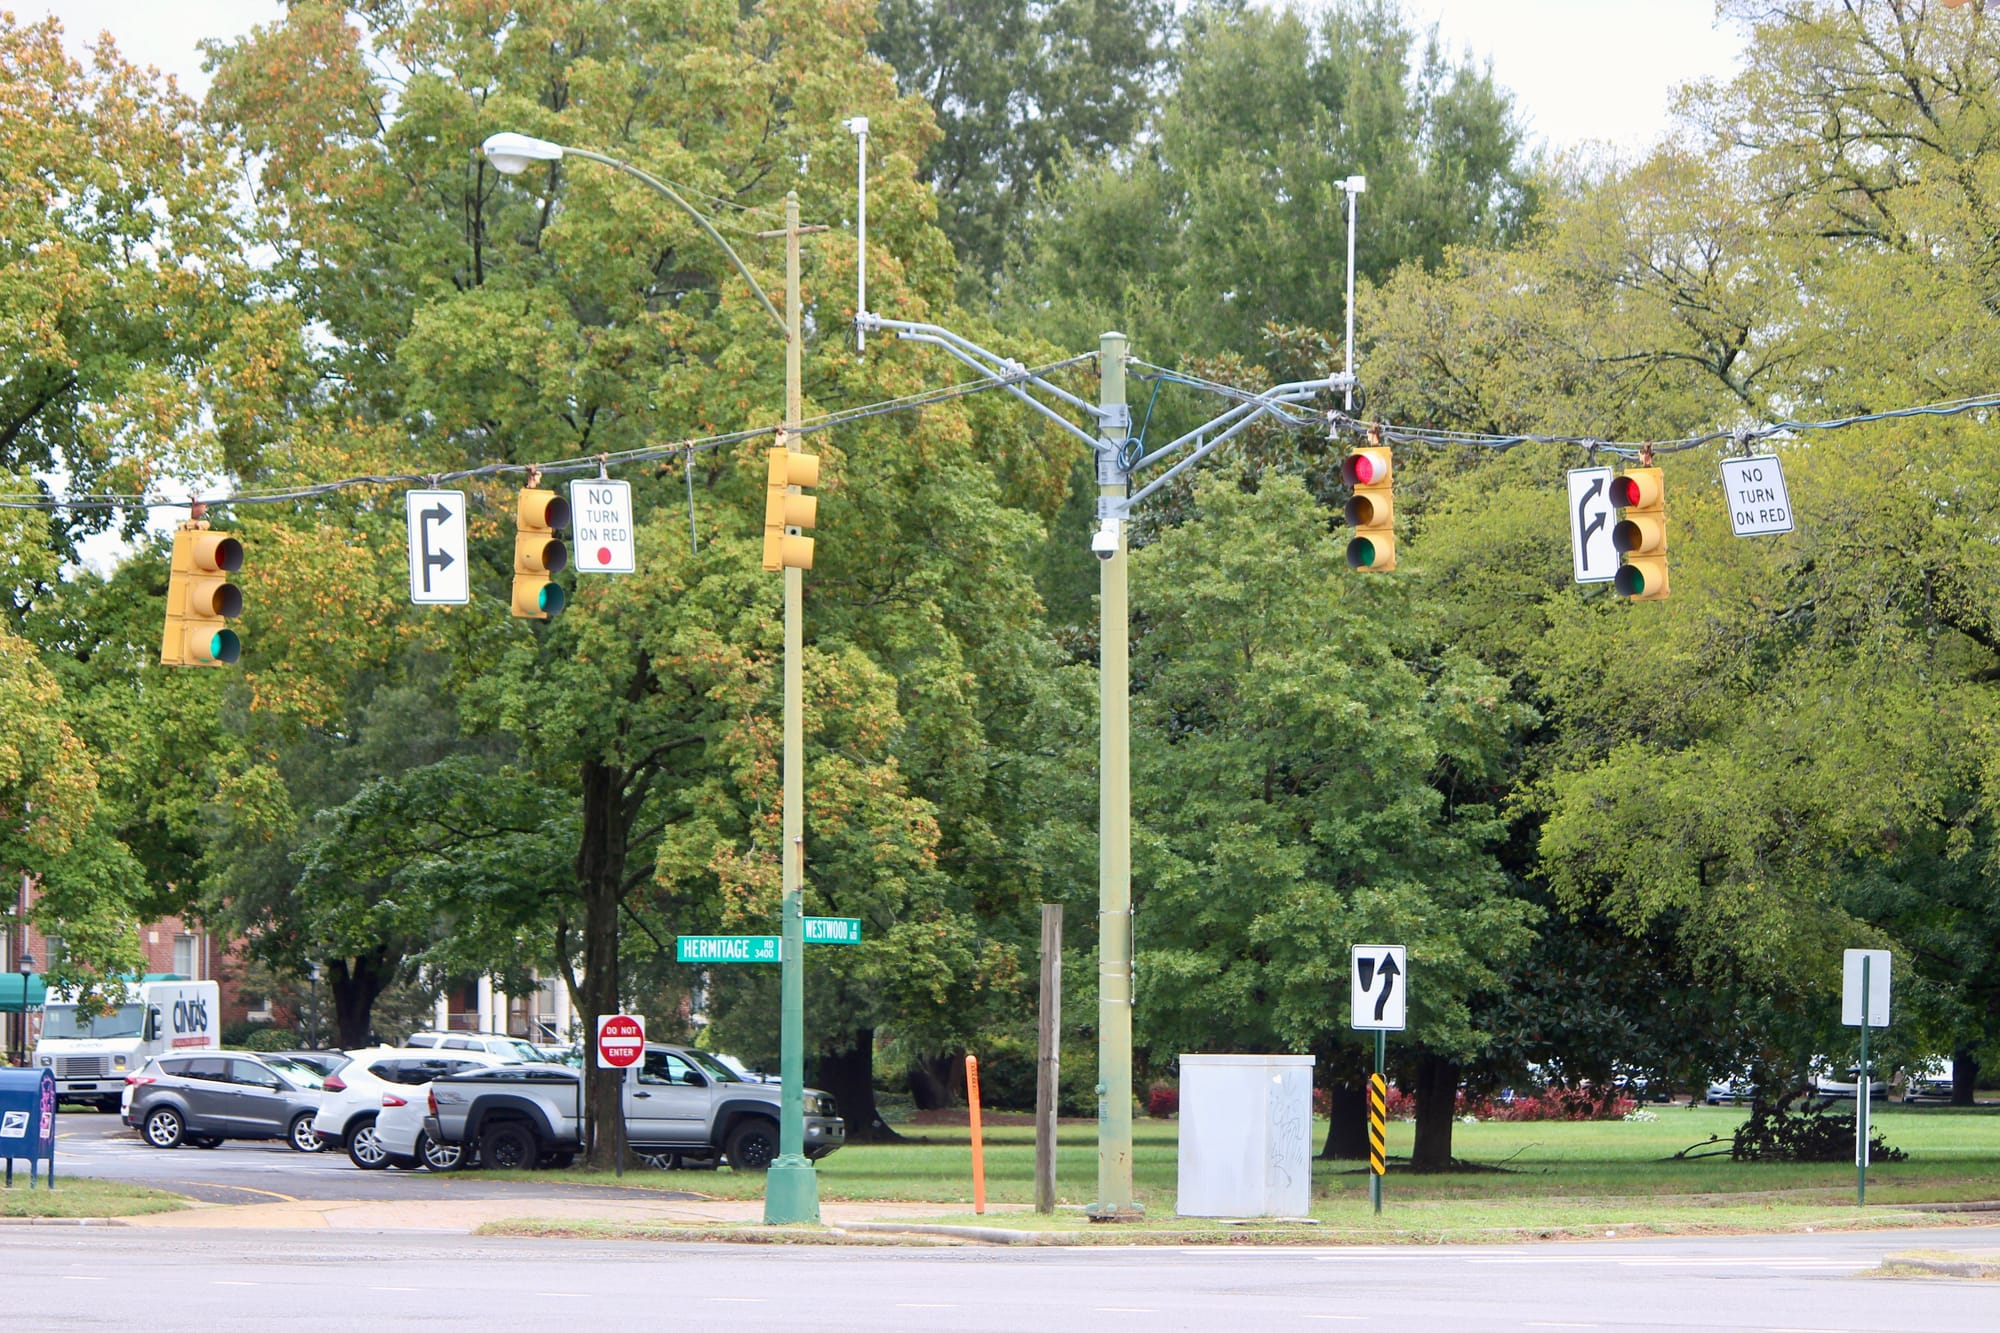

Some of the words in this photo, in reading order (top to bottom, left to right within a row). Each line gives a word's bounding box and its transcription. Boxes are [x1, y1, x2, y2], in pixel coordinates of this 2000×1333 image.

[1741, 468, 1763, 483] NO
[588, 488, 613, 505] NO
[1738, 487, 1775, 504] TURN
[586, 509, 619, 523] TURN
[1736, 510, 1755, 526] ON
[1759, 507, 1786, 523] RED
[580, 527, 597, 541] ON
[603, 528, 627, 541] RED
[805, 919, 848, 940] WESTWOOD
[683, 939, 750, 958] HERMITAGE
[763, 940, 774, 949] RD
[754, 949, 774, 959] 3400
[606, 1026, 617, 1035] DO
[621, 1026, 637, 1035] NOT
[609, 1048, 634, 1057] ENTER
